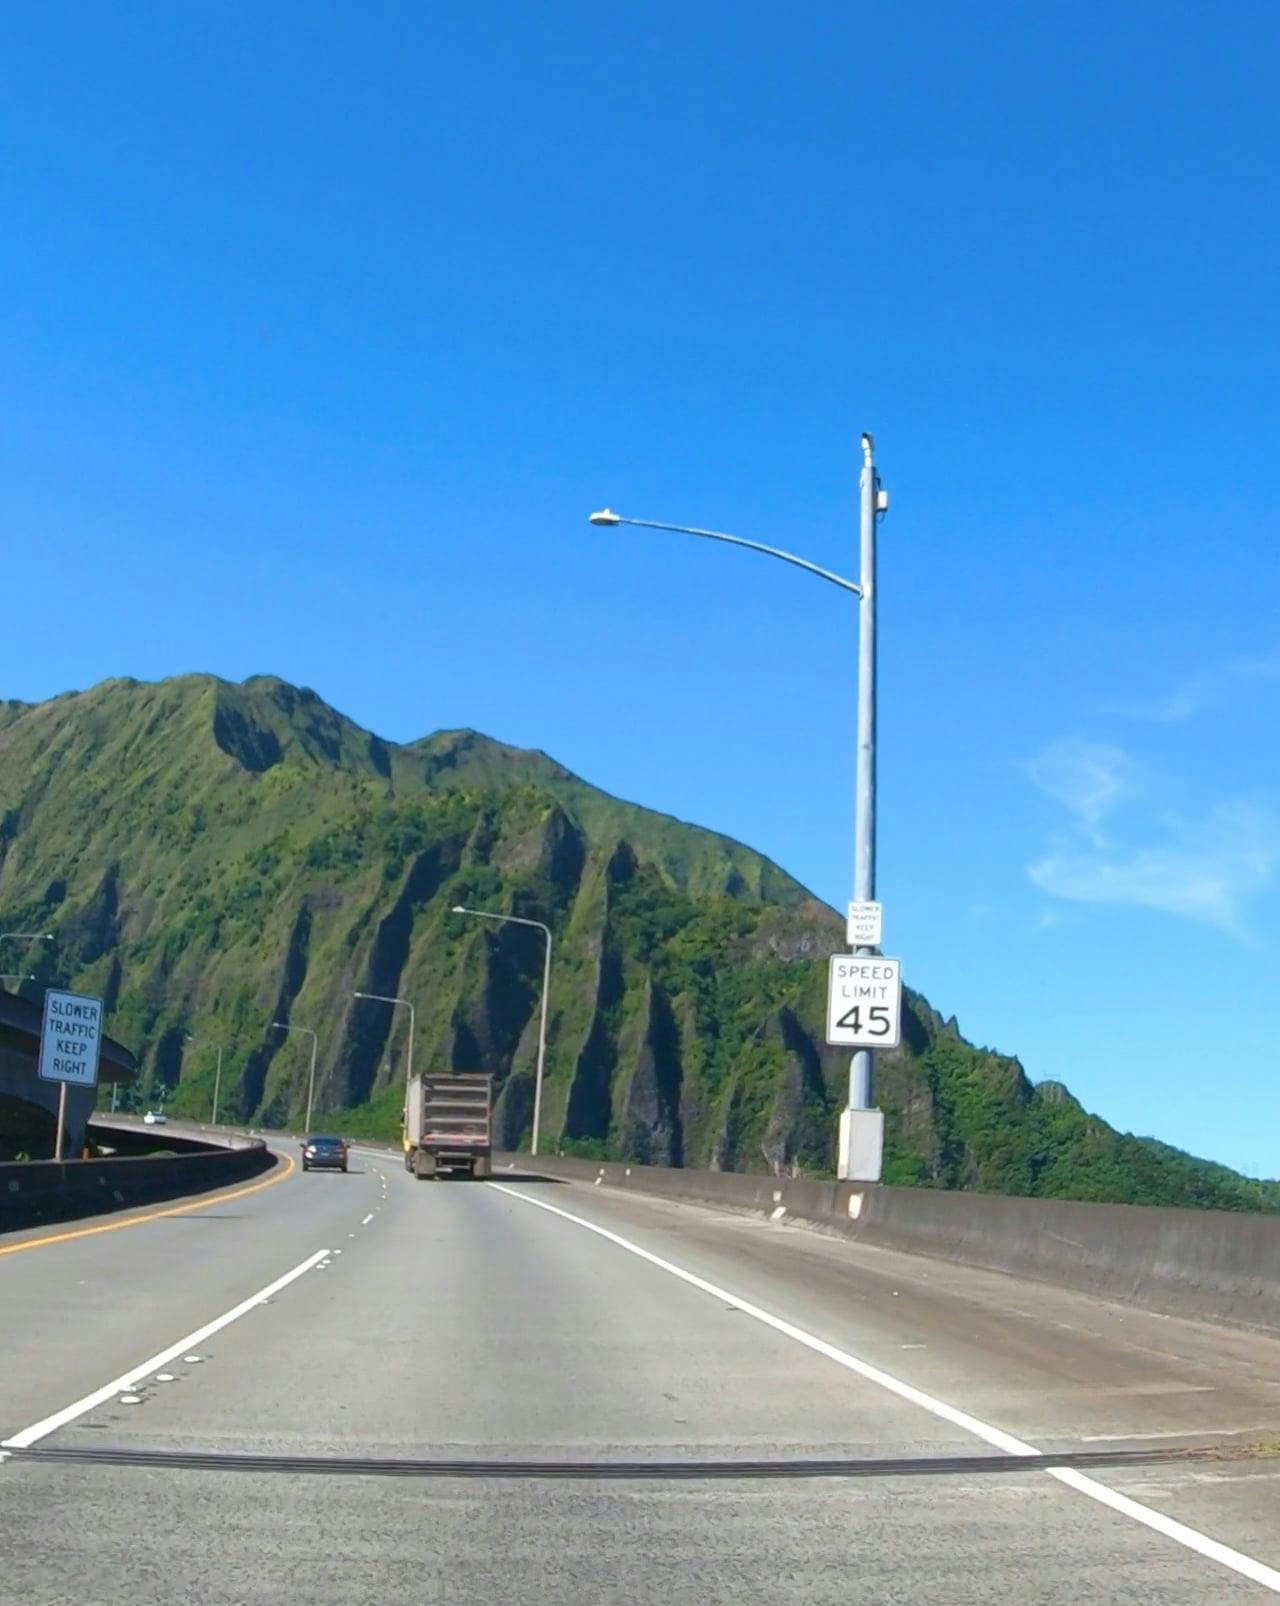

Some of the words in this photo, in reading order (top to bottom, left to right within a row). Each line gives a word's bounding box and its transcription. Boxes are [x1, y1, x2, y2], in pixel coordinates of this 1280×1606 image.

[838, 965, 894, 980] SPEED
[842, 985, 887, 1000] LIMIT
[51, 1001, 97, 1020] SLOWER
[49, 1019, 95, 1039] TRAFFIC
[836, 1005, 890, 1036] 45
[56, 1038, 87, 1056] KEEP
[53, 1058, 87, 1076] RIGHT
